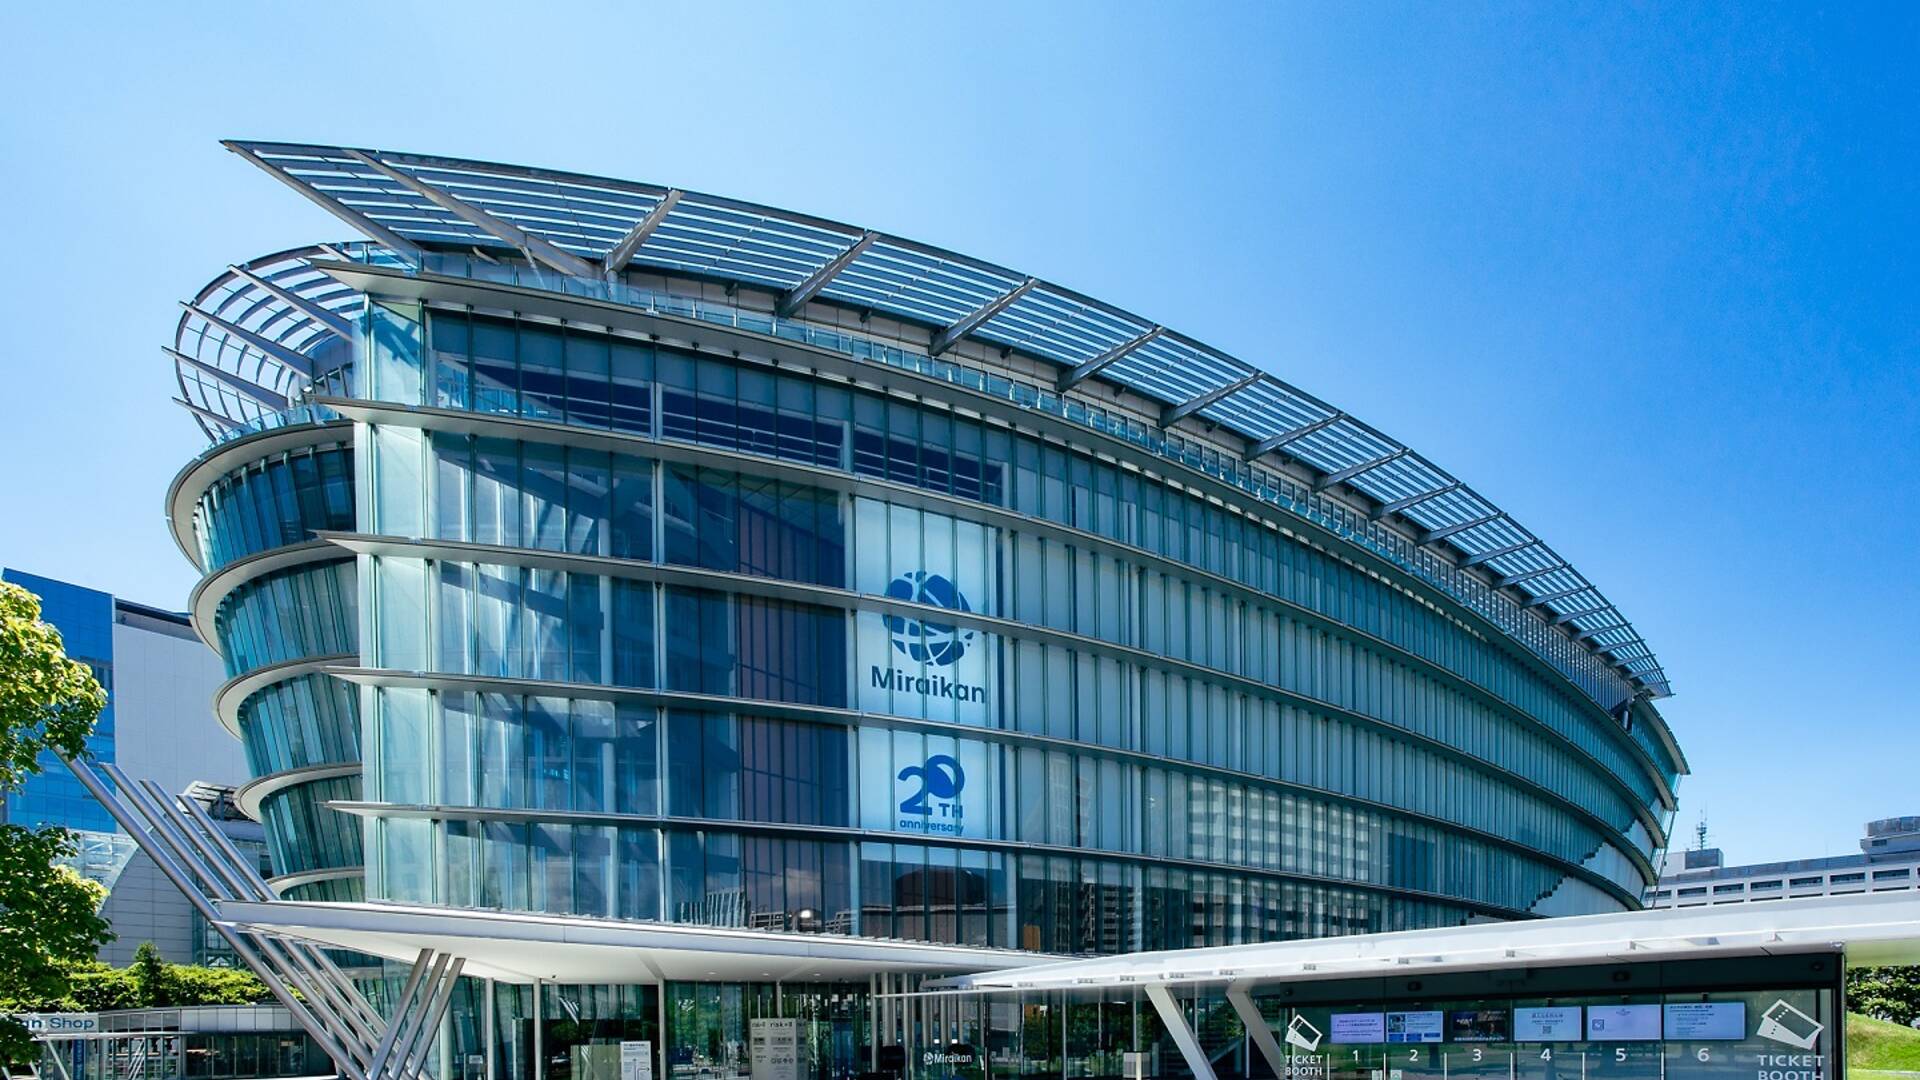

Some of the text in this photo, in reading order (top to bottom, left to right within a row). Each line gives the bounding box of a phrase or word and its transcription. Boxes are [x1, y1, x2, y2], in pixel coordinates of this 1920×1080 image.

[872, 665, 985, 704] Miraikan
[49, 1017, 94, 1030] Shop
[934, 1052, 972, 1063] Miraikan
[1285, 1054, 1323, 1064] TICKET
[1353, 1049, 1359, 1061] 1
[1409, 1049, 1419, 1062] 2
[1472, 1048, 1482, 1062] 3
[1540, 1048, 1551, 1061] 4
[1615, 1048, 1626, 1062] 5
[1697, 1048, 1710, 1062] 6
[1756, 1054, 1825, 1067] TICKET
[1284, 1066, 1323, 1076] BOOTH
[1757, 1070, 1825, 1080] BOOTH
